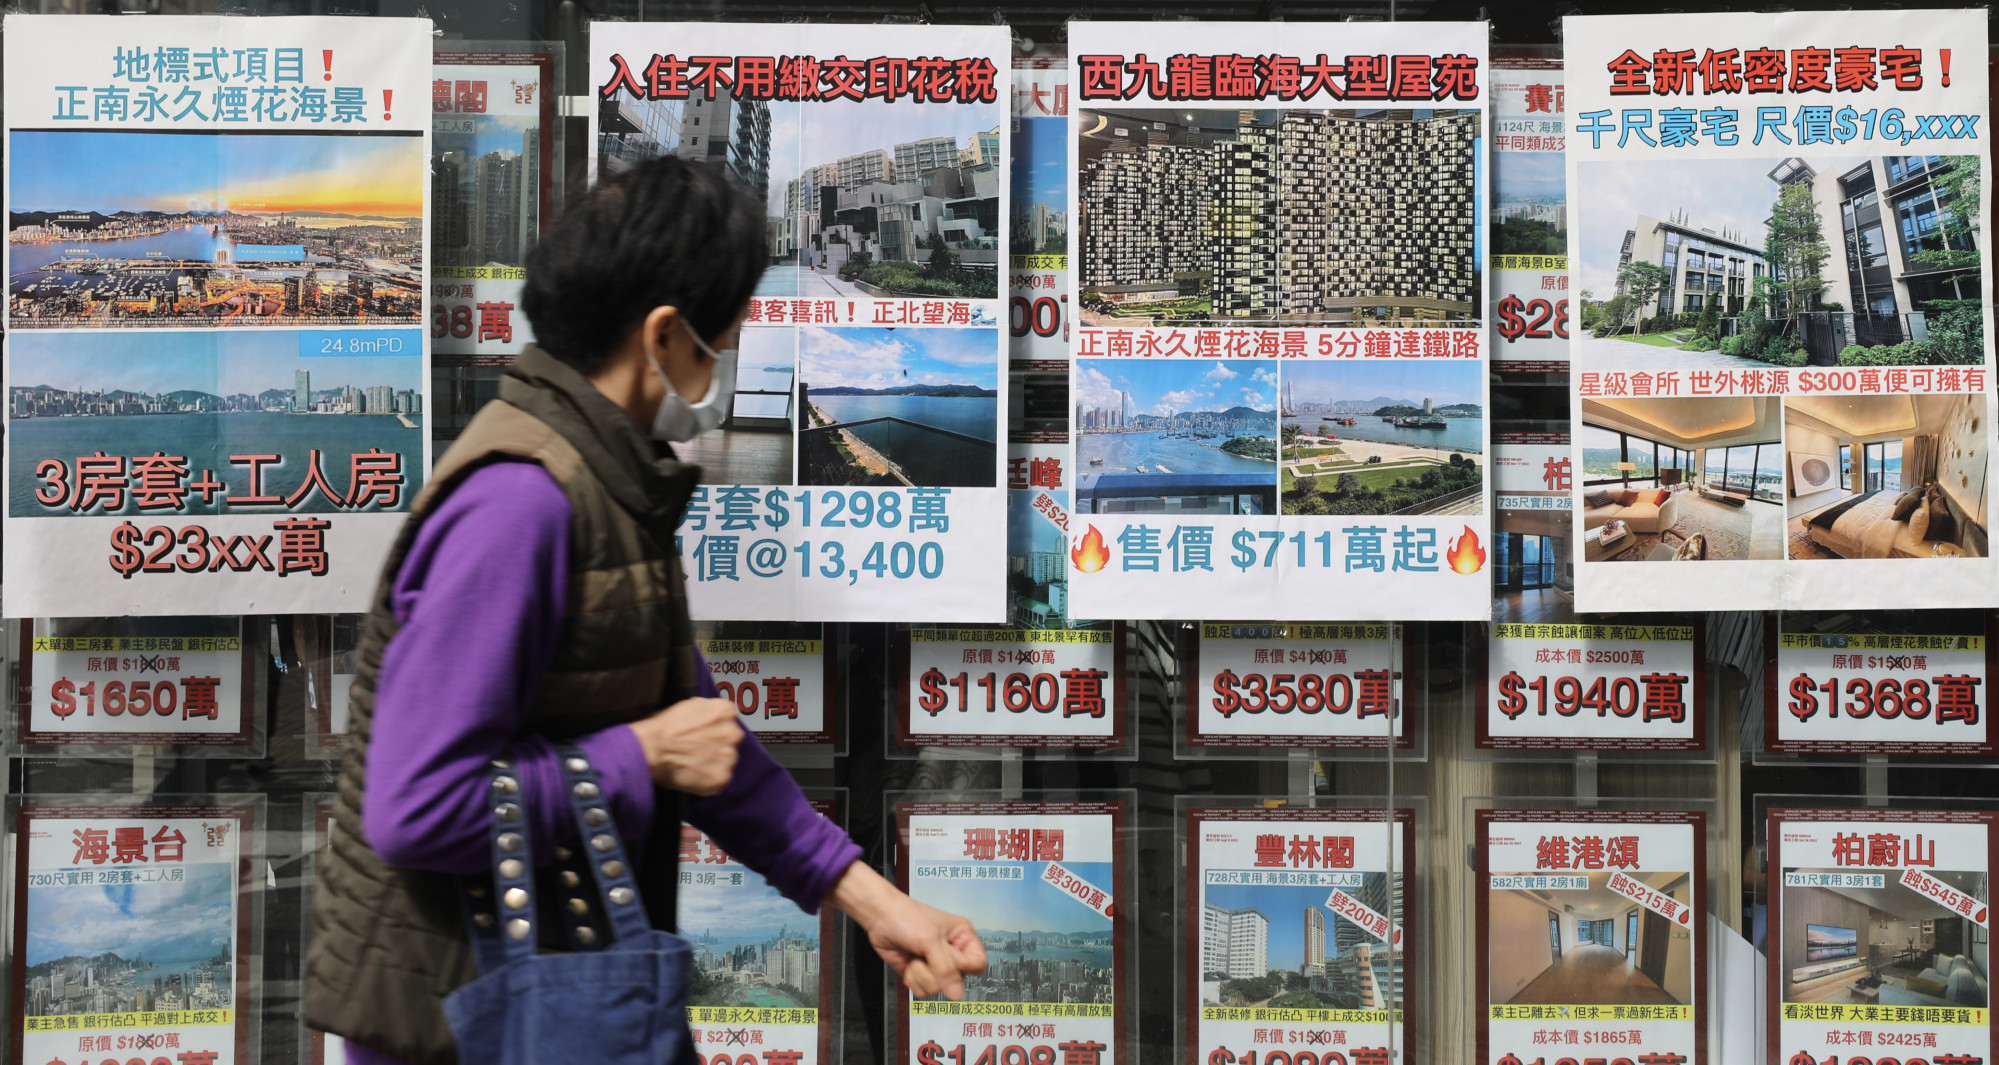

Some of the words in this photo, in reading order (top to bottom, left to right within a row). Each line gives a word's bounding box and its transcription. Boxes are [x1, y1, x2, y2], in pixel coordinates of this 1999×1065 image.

[602, 53, 998, 103] 入住不用繳交印花稅
[1078, 53, 1479, 102] 西九龍臨海大型屋苑
[1607, 46, 1952, 96] 全新低密度豪宅！
[1496, 121, 1535, 133] 1124尺
[1538, 121, 1565, 133] 海景
[1576, 106, 1739, 149] 千尺豪宅
[1752, 105, 1979, 148] 尺價$16,xxx
[1491, 256, 1567, 270] 高層海景B室
[871, 301, 970, 325] 正北望海
[321, 336, 403, 354] 24.8mPD
[1078, 330, 1309, 358] 正南永久煙花海景
[1317, 330, 1480, 359] 5分鐘達鐵路
[1579, 371, 1681, 397] 星級會所
[1689, 370, 1790, 395] 世外桃源
[1798, 368, 1986, 394] $300萬便可擁有
[35, 448, 404, 511] 3房套+工人房
[1543, 456, 1572, 490] 柏
[1498, 497, 1553, 509] 735尺實用
[109, 516, 331, 578] $23xx萬
[1117, 524, 1214, 573] 售價
[1230, 524, 1440, 573] $711萬起
[912, 630, 1026, 643] 平同類單位超過200萬
[1030, 631, 1113, 644] 東北景罕有放售
[1496, 625, 1606, 639] 榮獲首宗蝕讓個案
[1610, 626, 1693, 641] 高位入低位出
[35, 638, 115, 652] 大單邊三房套
[118, 638, 185, 651] 業主移民盤
[187, 637, 240, 651] 銀行估凸
[707, 641, 755, 653] 品味裝修
[87, 657, 118, 672] 原價
[962, 649, 993, 664] 原價
[1254, 649, 1285, 664] 原價
[1535, 648, 1582, 664] 成本價
[1586, 650, 1645, 665] $2500萬
[1832, 655, 1863, 669] 原價
[50, 675, 221, 721] $1650萬
[918, 667, 1108, 719] $1160萬
[1212, 668, 1402, 720] $3580萬
[1497, 670, 1689, 723] $1940萬
[1788, 672, 1982, 725] $1368萬
[72, 825, 187, 865] 海景台
[962, 828, 1064, 862] 珊瑚閣
[1254, 834, 1355, 869] 豐林閣
[1536, 835, 1640, 869] 維港頌
[1832, 832, 1935, 867] 柏蔚山
[28, 872, 94, 887] 730尺實用
[98, 868, 184, 884] 2房套+工人房
[696, 872, 743, 885] 3房一套
[917, 866, 972, 879] 654尺實用
[975, 866, 1022, 879] 海景樓皇
[1208, 872, 1263, 884] 728尺實用
[1266, 872, 1361, 886] 海景3房套+工人房
[1787, 874, 1842, 886] 781尺實用
[1845, 875, 1883, 887] 3房1套
[1044, 864, 1108, 911] 劈300萬
[1491, 877, 1547, 889] 582尺實用
[1609, 872, 1680, 918] 蝕$215萬
[1903, 868, 1976, 917] 蝕$545萬
[1328, 890, 1390, 938] 劈200萬
[699, 1008, 816, 1024] 單邊永久煙花海景
[912, 1003, 1024, 1016] 平過同層成交$200萬
[1028, 1004, 1113, 1017] 極罕有高層放售
[1204, 1009, 1252, 1021] 全新裝修
[1255, 1009, 1303, 1022] 銀行估凸
[1492, 1006, 1558, 1019] 業主已離去
[1784, 1005, 1845, 1020] 看淡世界
[26, 1016, 80, 1031] 業主急售
[83, 1014, 136, 1029] 銀行估凸
[962, 1023, 993, 1038] 原價
[78, 1036, 112, 1052] 原價
[1253, 1028, 1284, 1044] 原價
[1532, 1029, 1579, 1045] 成本價
[1584, 1030, 1643, 1045] $1865萬
[1825, 1030, 1873, 1046] 成本價
[1877, 1032, 1937, 1048] $2425萬
